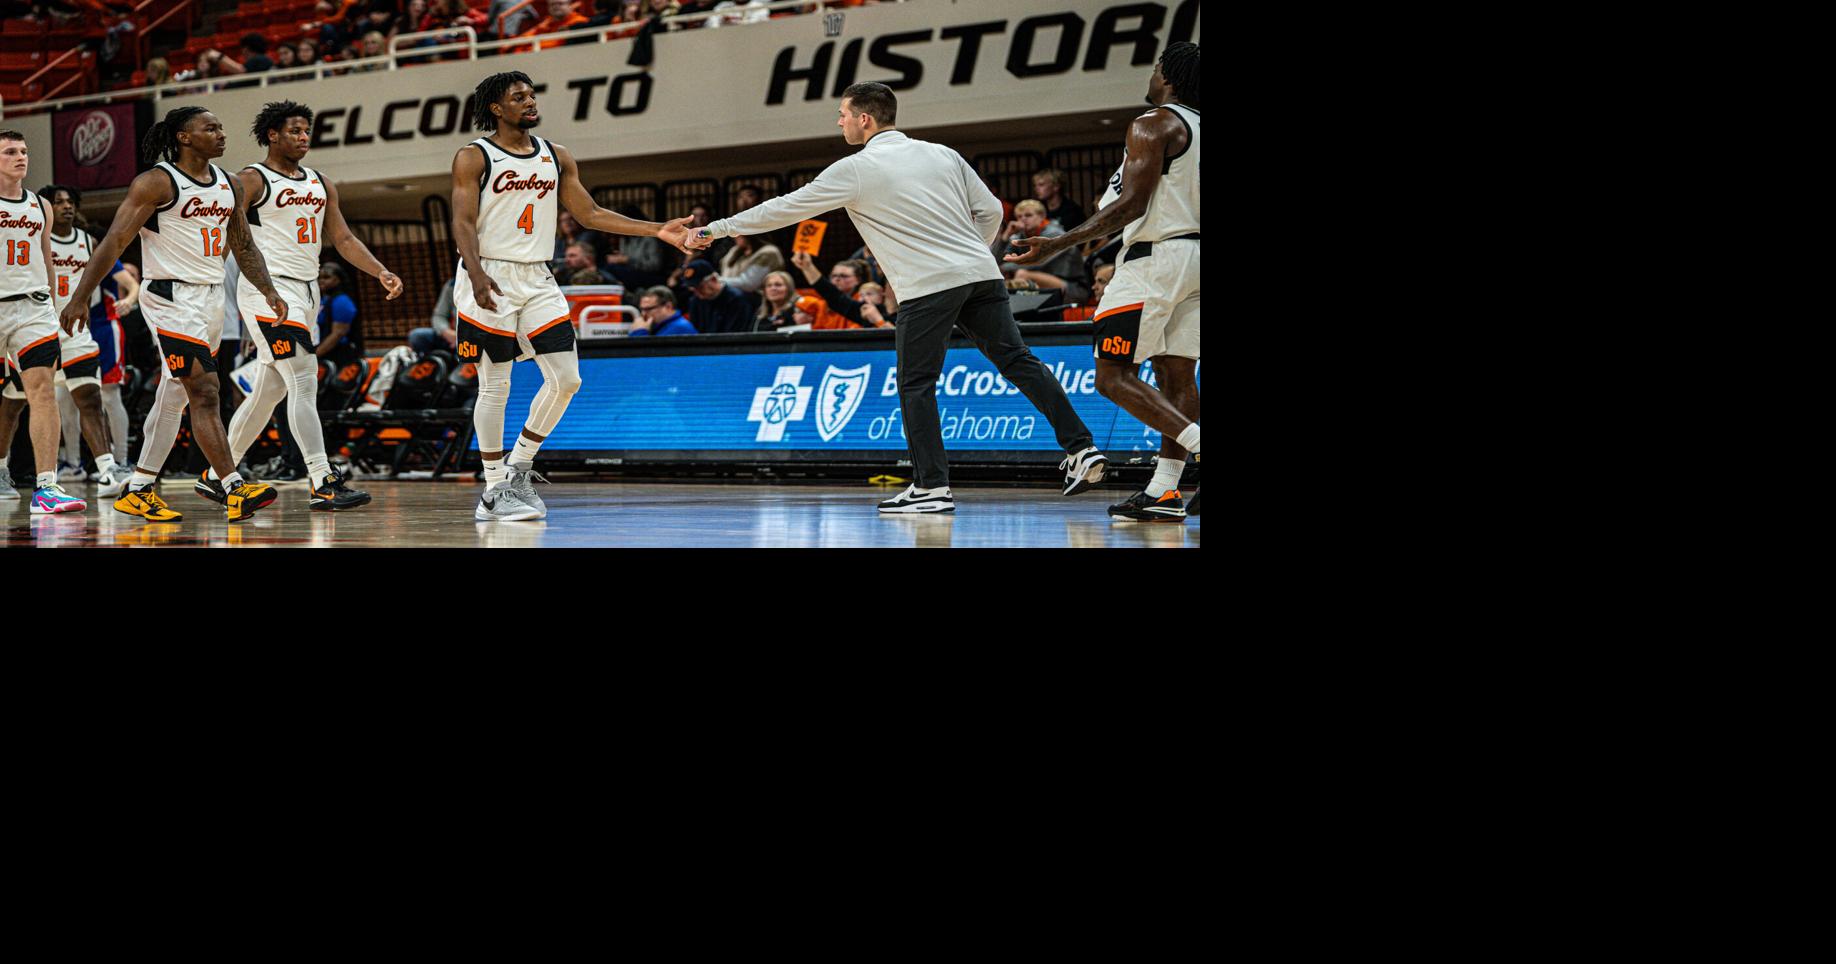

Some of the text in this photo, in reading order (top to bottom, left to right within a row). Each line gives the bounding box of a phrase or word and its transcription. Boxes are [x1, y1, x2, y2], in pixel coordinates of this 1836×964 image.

[309, 83, 547, 150] ELCO
[567, 72, 655, 121] TO
[492, 170, 556, 199] Cowboys
[276, 188, 325, 214] Cowboy
[296, 217, 317, 244] 21
[517, 203, 533, 234] 4
[7, 239, 30, 265] 13
[200, 227, 222, 257] 12
[57, 275, 69, 297] 5
[868, 408, 1036, 440] of lahoma
